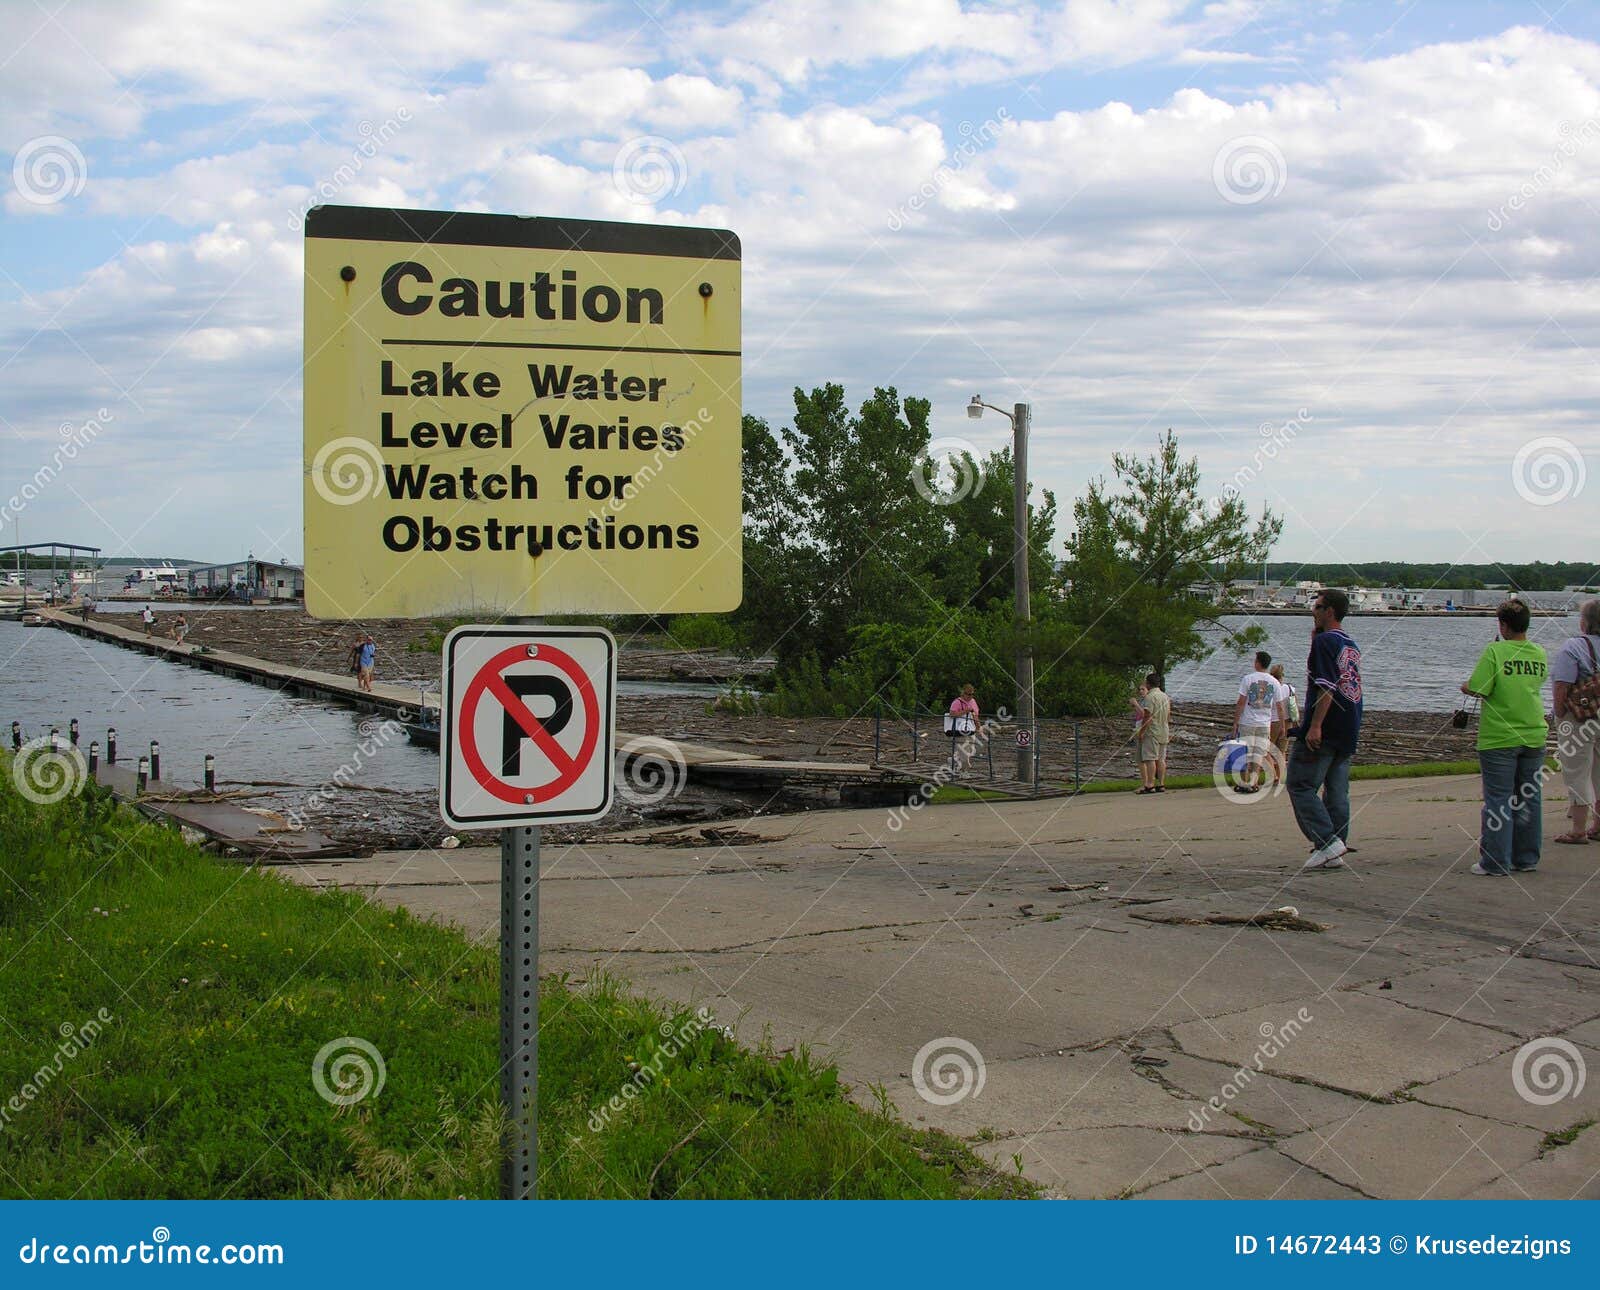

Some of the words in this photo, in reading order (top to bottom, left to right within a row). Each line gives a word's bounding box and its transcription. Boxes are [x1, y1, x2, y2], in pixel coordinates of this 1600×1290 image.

[381, 262, 664, 325] Caution
[381, 360, 501, 398] Lake
[527, 364, 667, 402] Water
[381, 412, 513, 449] Level
[539, 414, 685, 452] Varies
[383, 464, 538, 501] Watch
[565, 465, 632, 501] for
[382, 516, 700, 553] Obstructions
[1503, 660, 1546, 677] STAFF
